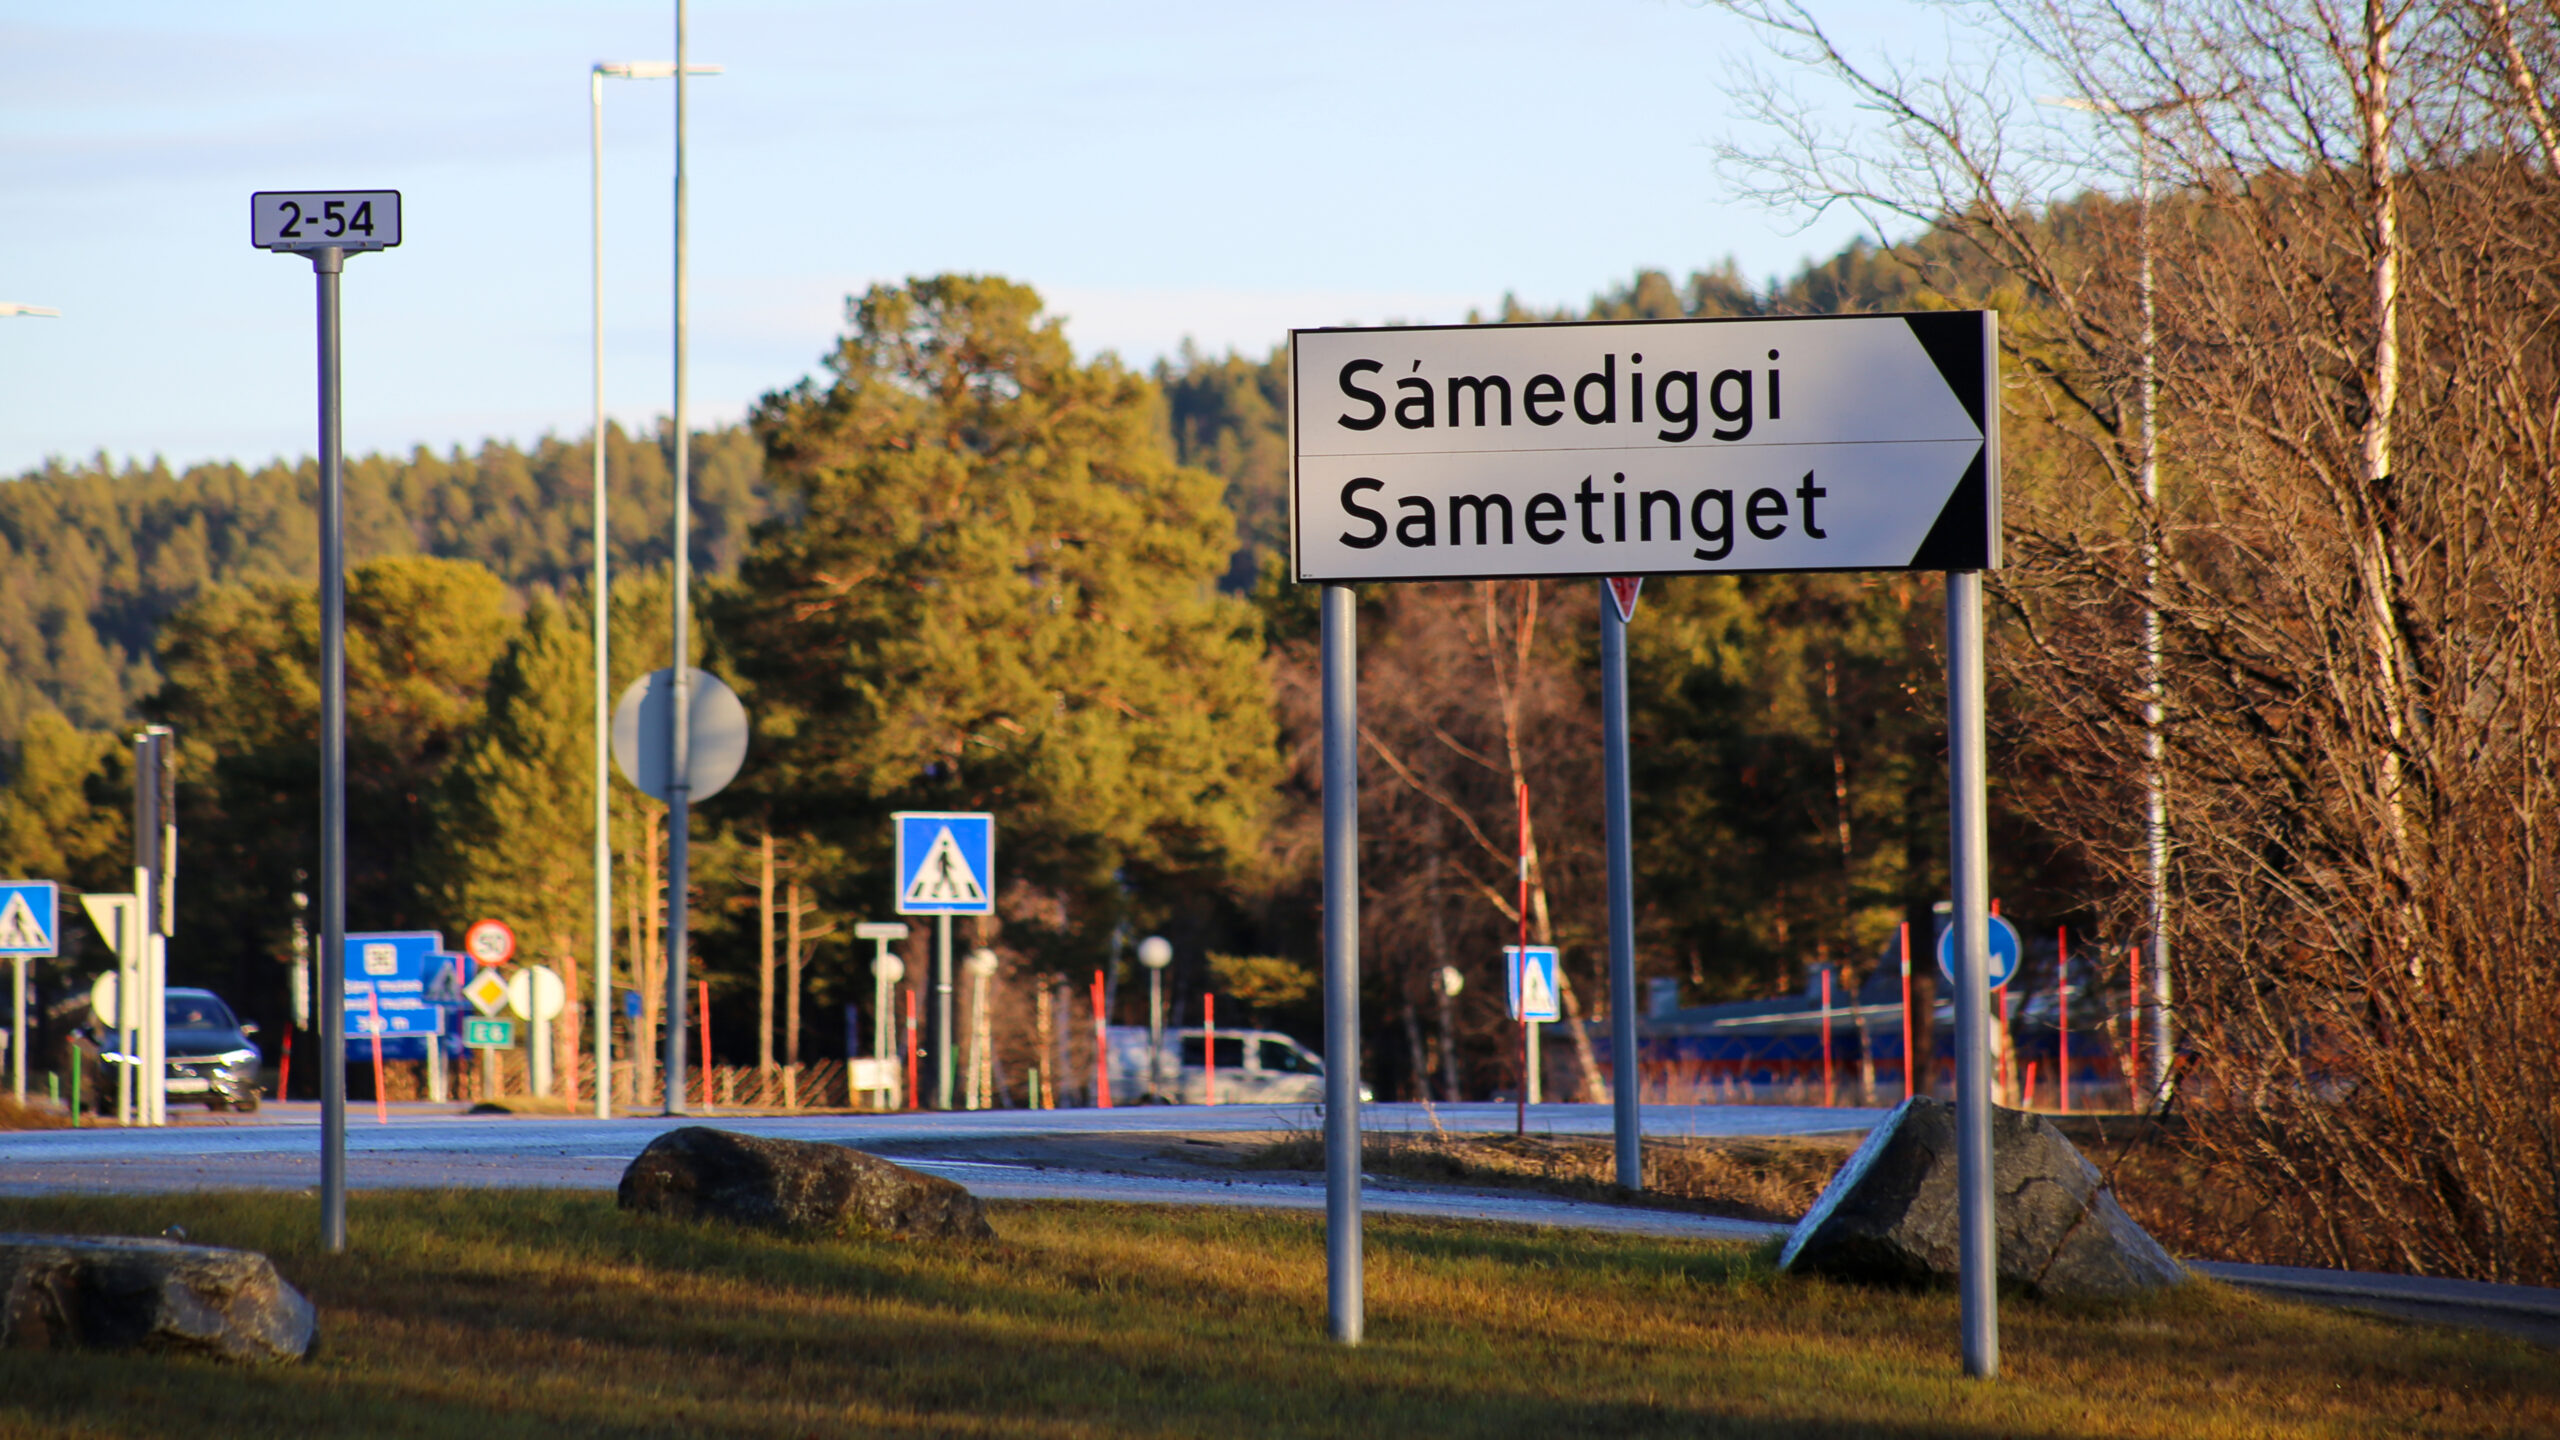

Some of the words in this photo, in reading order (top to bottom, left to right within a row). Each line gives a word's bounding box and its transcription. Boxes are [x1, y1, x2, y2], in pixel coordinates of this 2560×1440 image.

[279, 200, 374, 238] 2-54
[1337, 348, 1782, 443] Sámediggi
[1339, 468, 1828, 562] Sametinget
[478, 933, 505, 954] 50
[473, 1022, 505, 1042] E6
